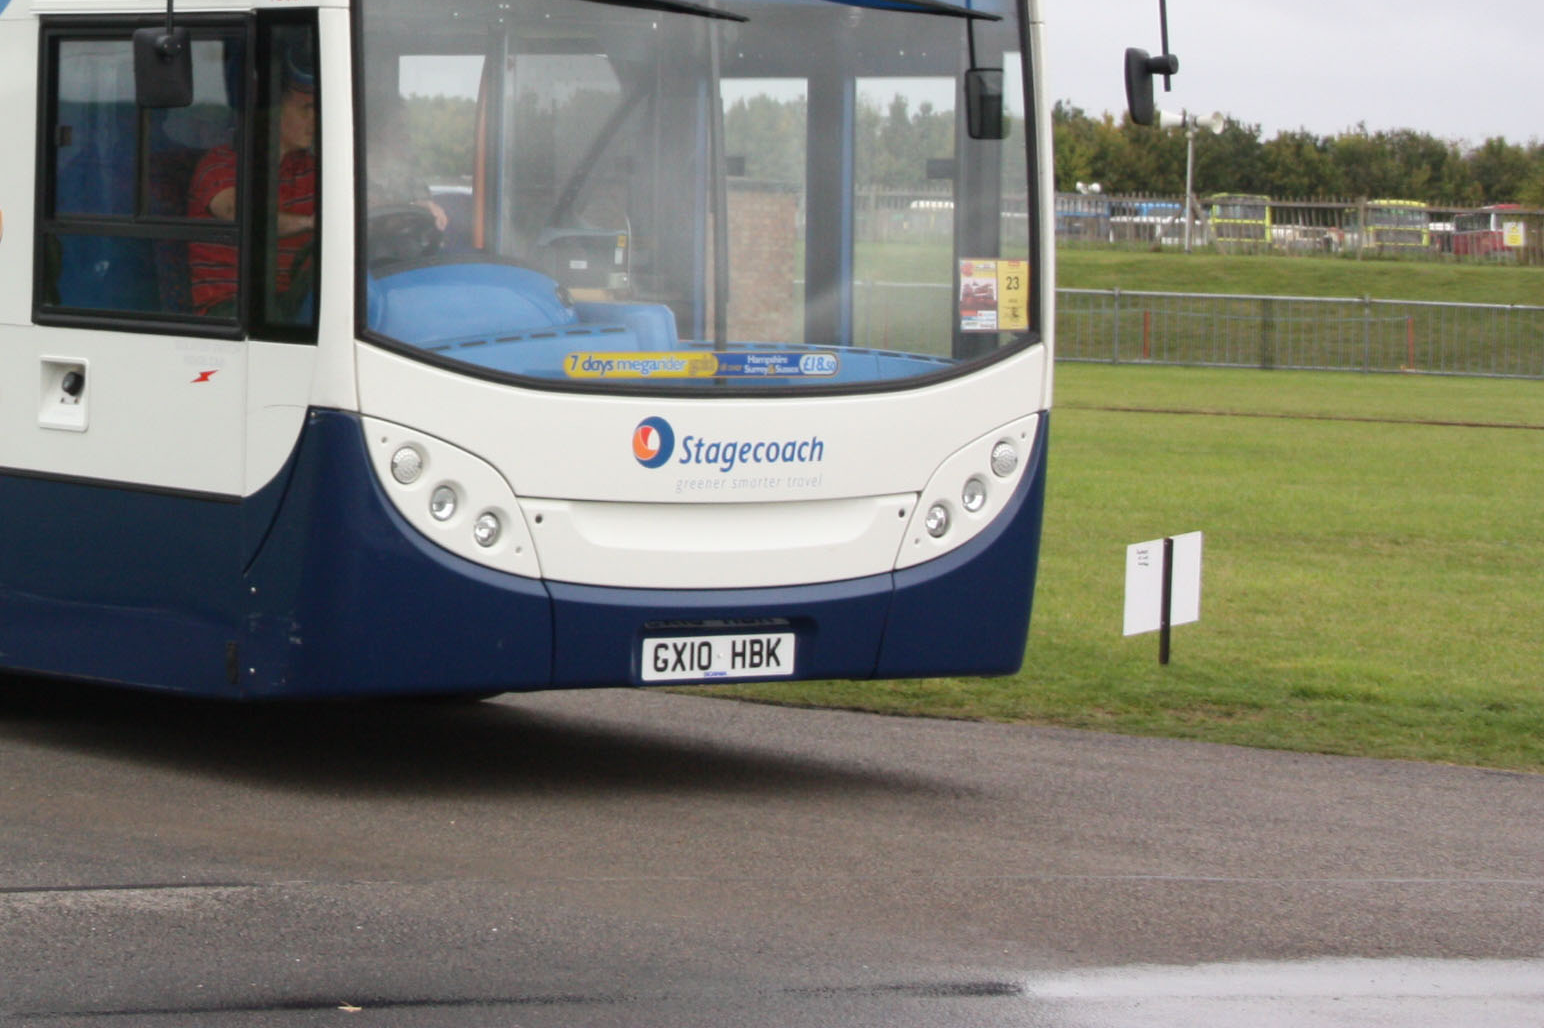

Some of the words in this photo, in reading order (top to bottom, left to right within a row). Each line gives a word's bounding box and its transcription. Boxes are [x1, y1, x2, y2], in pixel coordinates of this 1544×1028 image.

[1006, 276, 1020, 291] 23
[570, 355, 579, 371] 7
[582, 355, 614, 376] days
[616, 356, 686, 376] megarider
[678, 436, 824, 472] Stagecoach
[675, 478, 726, 493] greener
[731, 476, 781, 489] smarter
[787, 473, 823, 487] travel
[653, 640, 712, 672] GX10
[731, 637, 782, 669] HBK
